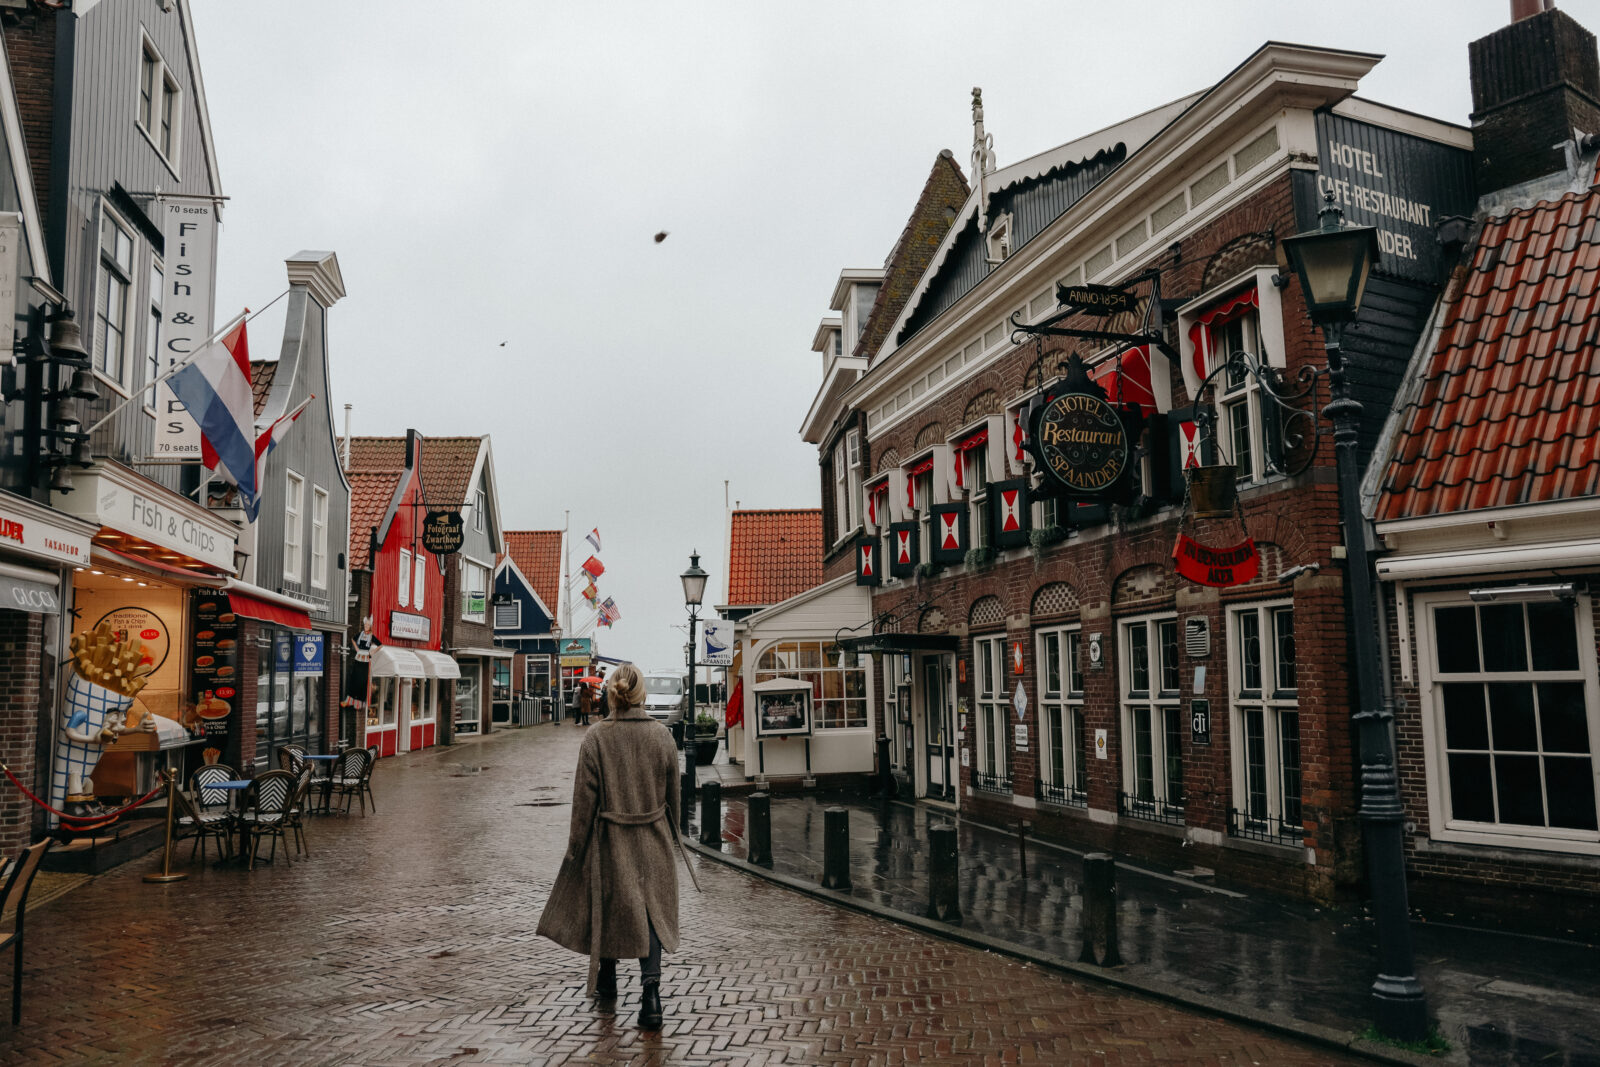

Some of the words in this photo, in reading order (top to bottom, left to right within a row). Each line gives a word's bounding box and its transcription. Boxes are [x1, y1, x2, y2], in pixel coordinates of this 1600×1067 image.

[1329, 140, 1383, 178] HOTEL
[169, 205, 180, 214] 70
[182, 206, 208, 215] seats
[174, 222, 197, 296] Fish
[1069, 290, 1098, 303] ANNO
[171, 312, 194, 325] &
[166, 337, 192, 434] Cps
[1057, 396, 1102, 418] HOTEL
[1043, 422, 1122, 445] Restaurant
[159, 443, 170, 452] 70
[173, 443, 199, 452] seats
[1051, 455, 1121, 487] SPAANDER
[132, 495, 162, 532] Fish
[168, 517, 177, 537] &
[182, 519, 215, 553] Chips
[427, 524, 459, 534] Fotograaf
[44, 538, 79, 556] TAXATEUR
